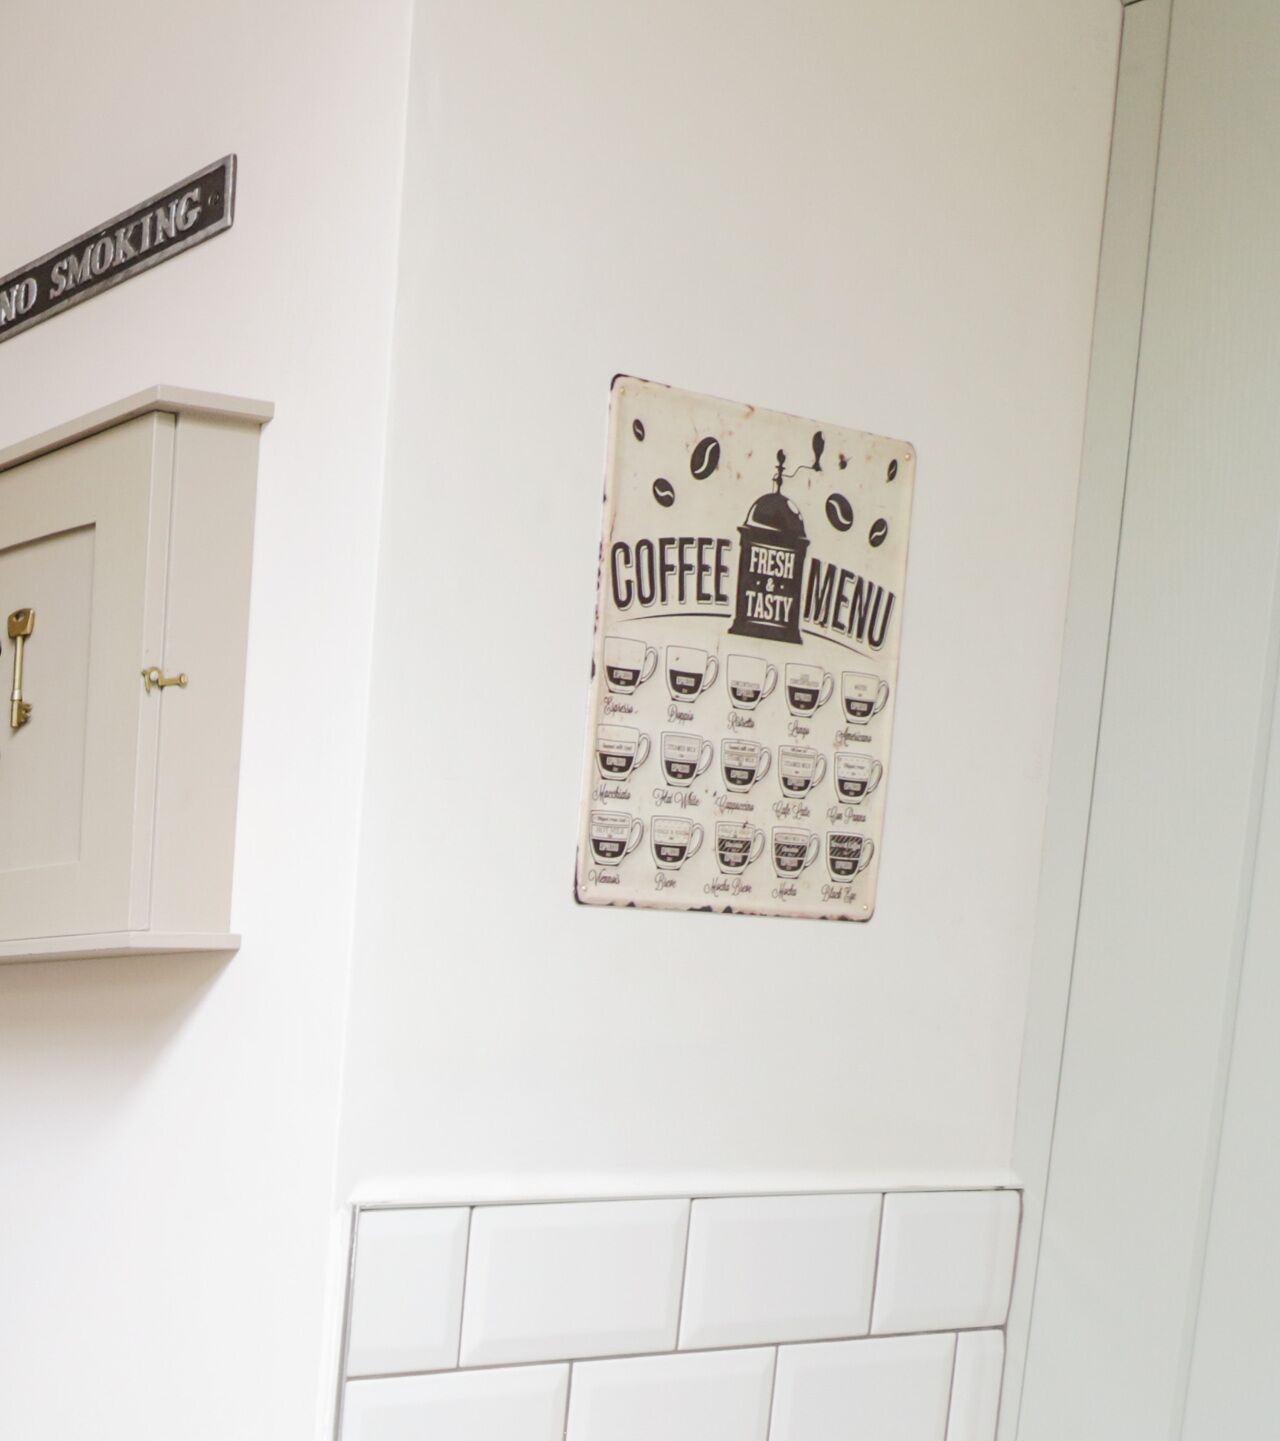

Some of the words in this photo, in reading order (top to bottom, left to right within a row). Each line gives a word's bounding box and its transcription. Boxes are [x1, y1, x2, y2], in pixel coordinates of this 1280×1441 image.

[50, 187, 202, 299] SMOKING
[610, 536, 733, 612] COFFEE
[803, 557, 897, 651] MENU
[749, 546, 795, 579] FRESH
[745, 590, 793, 623] TASTY
